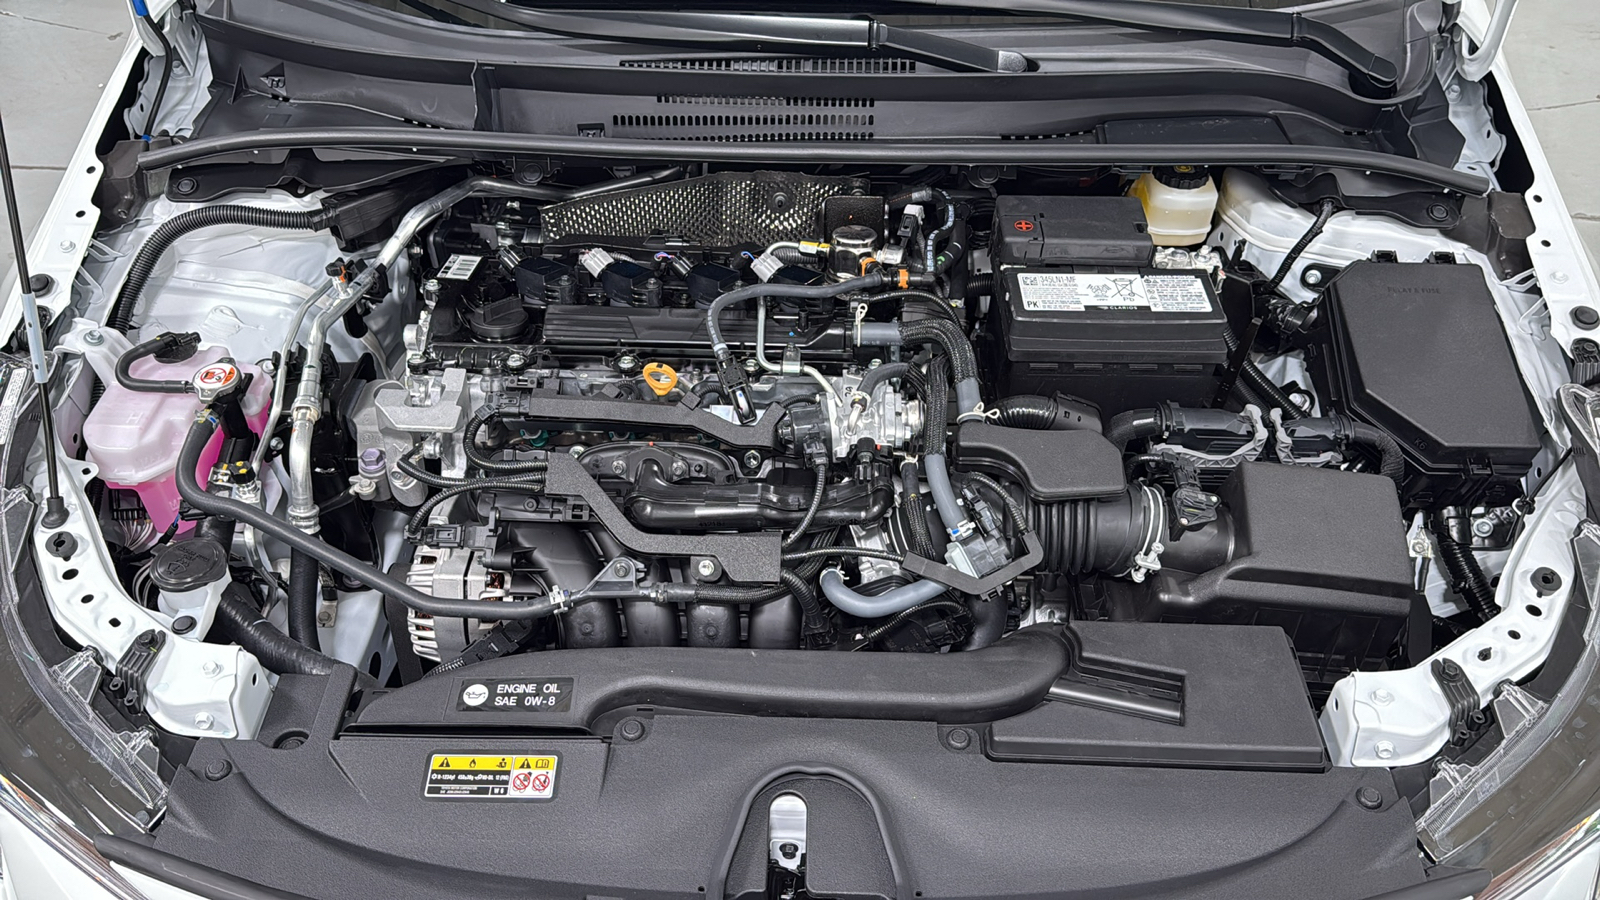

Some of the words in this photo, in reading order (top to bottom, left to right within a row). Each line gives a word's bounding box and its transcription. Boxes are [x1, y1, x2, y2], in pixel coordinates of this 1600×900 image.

[1026, 300, 1039, 308] PK
[496, 683, 537, 694] ENGINE
[542, 683, 561, 693] OIL
[494, 696, 518, 706] SAE
[524, 696, 556, 706] 0W-8
